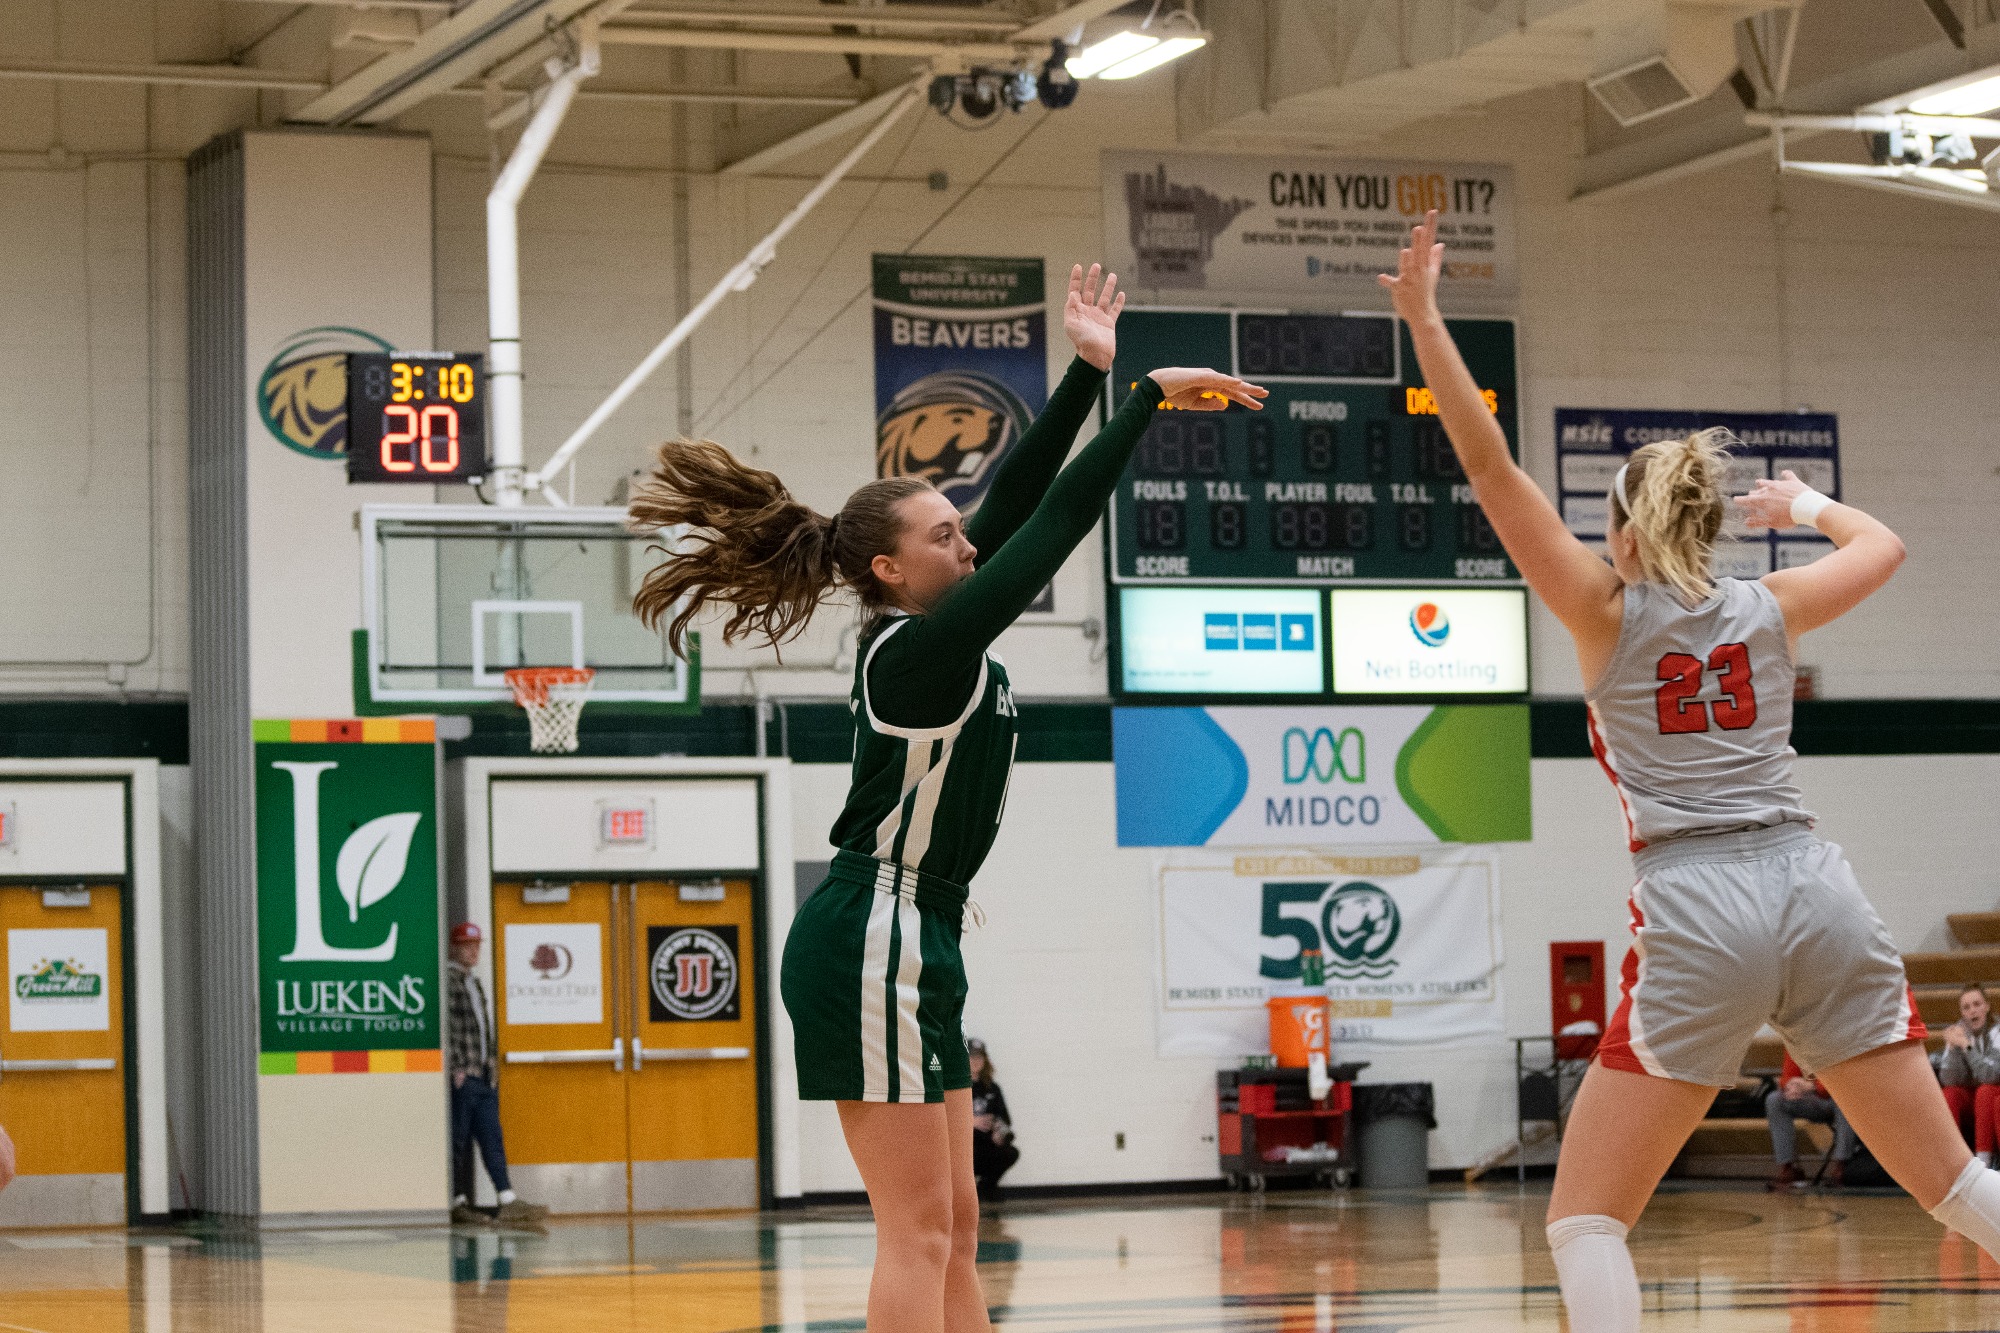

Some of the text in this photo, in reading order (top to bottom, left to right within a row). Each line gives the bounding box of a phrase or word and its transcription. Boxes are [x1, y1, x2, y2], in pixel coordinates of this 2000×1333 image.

[1269, 171, 1496, 216] CAN YOU GIG IT?
[968, 273, 1018, 287] STATE
[891, 316, 1031, 348] BEAVERS
[391, 362, 475, 403] 3:10
[1289, 401, 1347, 422] PERIOD
[380, 405, 459, 473] 20
[1133, 480, 1188, 501] FOULS
[1204, 482, 1250, 502] T.O.L.
[1265, 484, 1328, 502] PLAYER
[1335, 485, 1377, 503] FOUL
[1391, 485, 1434, 503] T.O.L.
[1135, 557, 1189, 576] SCORE
[1297, 558, 1354, 577] MATCH
[1455, 558, 1506, 578] SCORE
[1365, 659, 1497, 684] Nei Bottling
[1655, 642, 1758, 735] 23
[611, 810, 646, 838] EXIT
[1265, 796, 1381, 827] MIDCO
[674, 953, 714, 998] JJ
[276, 974, 427, 1017] LUEKEN'S
[277, 1017, 427, 1034] VILLAGE FOODS
